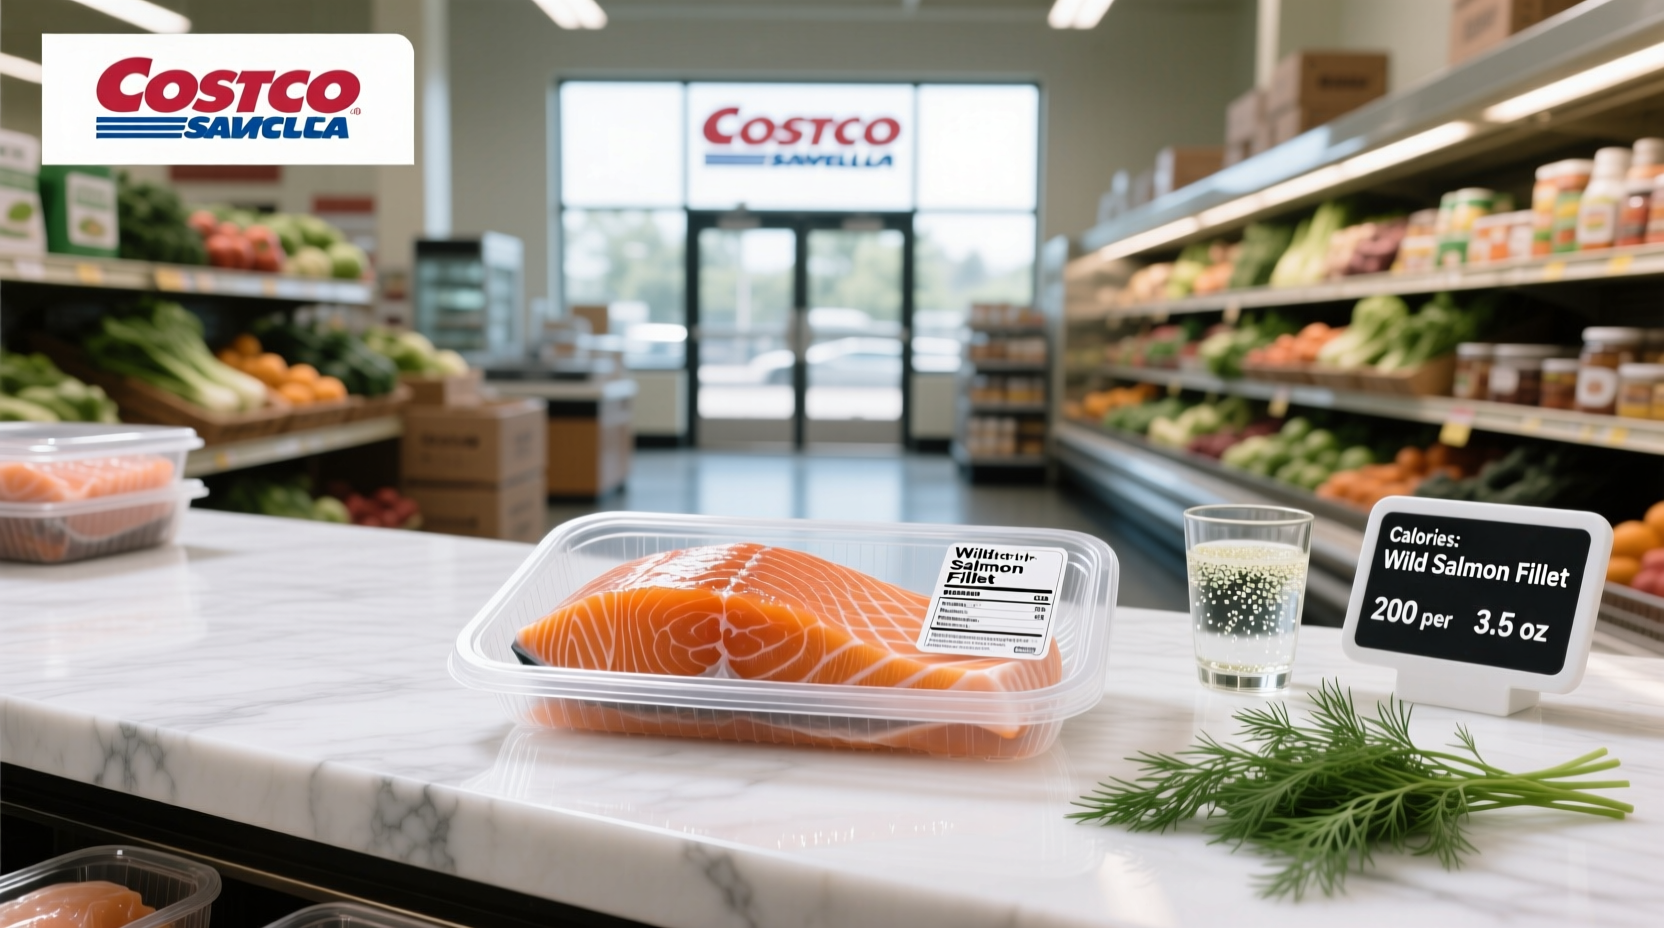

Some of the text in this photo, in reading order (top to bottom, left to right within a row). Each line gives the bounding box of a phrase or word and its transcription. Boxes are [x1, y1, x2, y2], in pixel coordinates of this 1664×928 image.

[703, 107, 901, 145] COSTCO
[1389, 526, 1461, 548] Calories:
[950, 559, 1024, 574] Salmon
[1384, 549, 1570, 588] Wild Salmon Fillet
[1370, 596, 1550, 643] 200 per 3.5 oz
